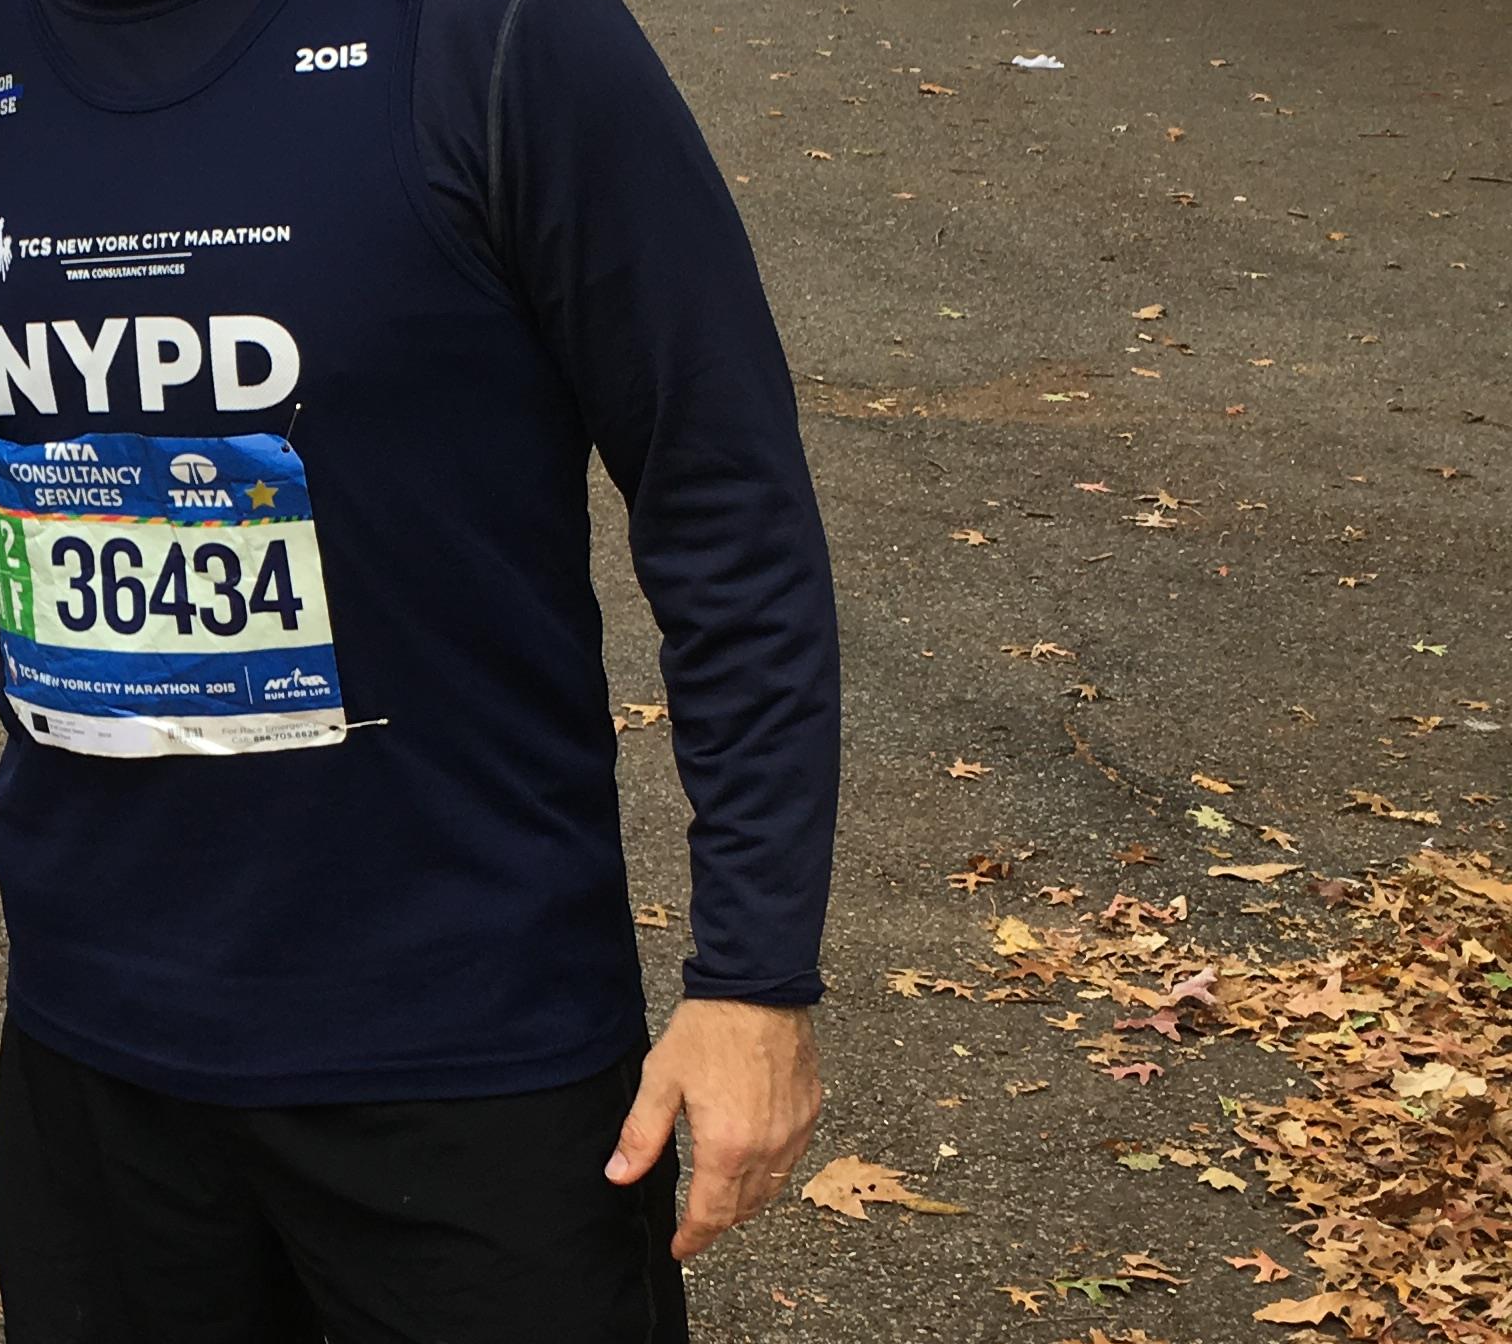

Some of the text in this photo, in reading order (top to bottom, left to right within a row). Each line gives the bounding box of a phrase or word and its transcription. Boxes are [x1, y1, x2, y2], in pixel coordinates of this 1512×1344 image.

[295, 43, 368, 72] 2015
[18, 225, 290, 257] TCS NEW YORK CITY MARATHON
[66, 263, 185, 280] TATA CONSULTANCY SERVICES
[44, 441, 99, 462] TATA
[9, 463, 142, 485] CONSULTANCY
[34, 487, 123, 507] SERVICES
[167, 489, 233, 508] TATA
[51, 536, 303, 637] 36434
[18, 663, 236, 695] TCS NEW YORK CITY MARATHON 2015
[264, 691, 285, 701] RUN
[287, 690, 307, 698] FOR
